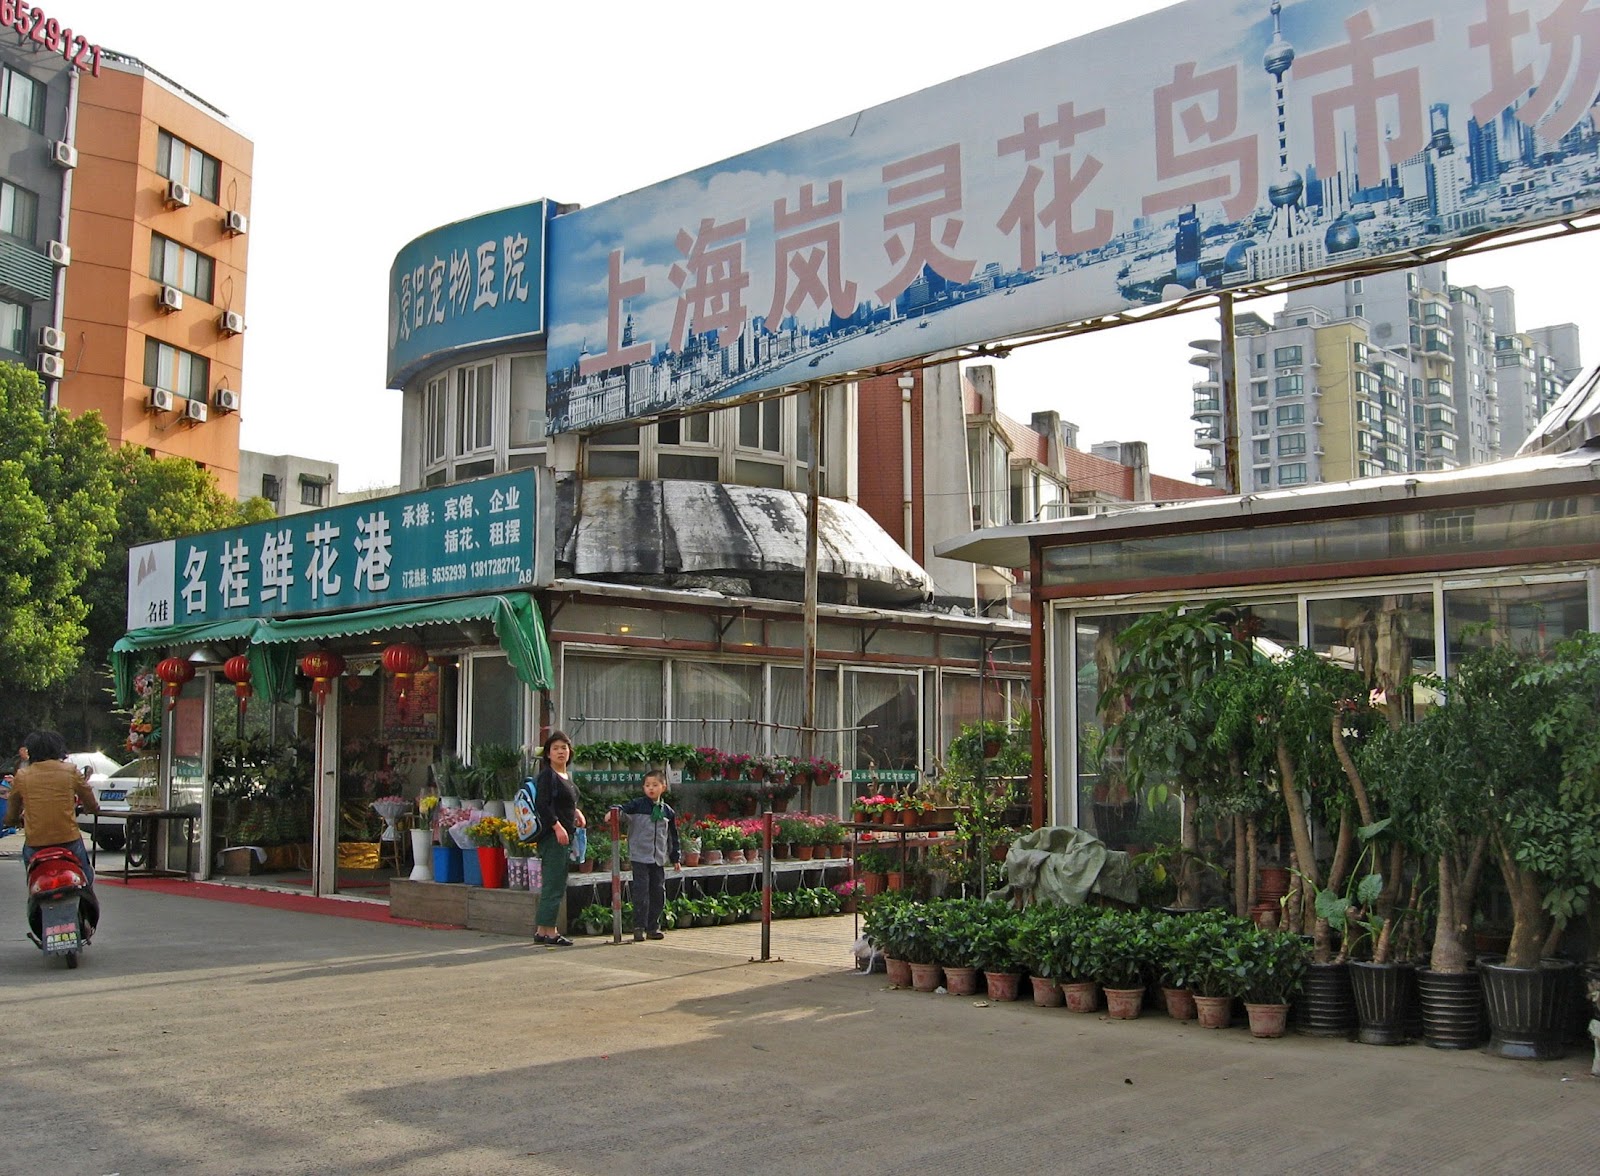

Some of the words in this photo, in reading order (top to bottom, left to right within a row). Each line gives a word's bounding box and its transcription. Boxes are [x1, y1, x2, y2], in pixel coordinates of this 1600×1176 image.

[0, 0, 101, 78] 6529121
[579, 0, 1600, 377] 上海岚灵花鸟市场
[180, 511, 393, 616] 名桂鲜花港
[432, 563, 467, 584] 56352939
[470, 556, 521, 578] 13817282712
[518, 568, 532, 584] A8
[147, 599, 169, 623] 名桂
